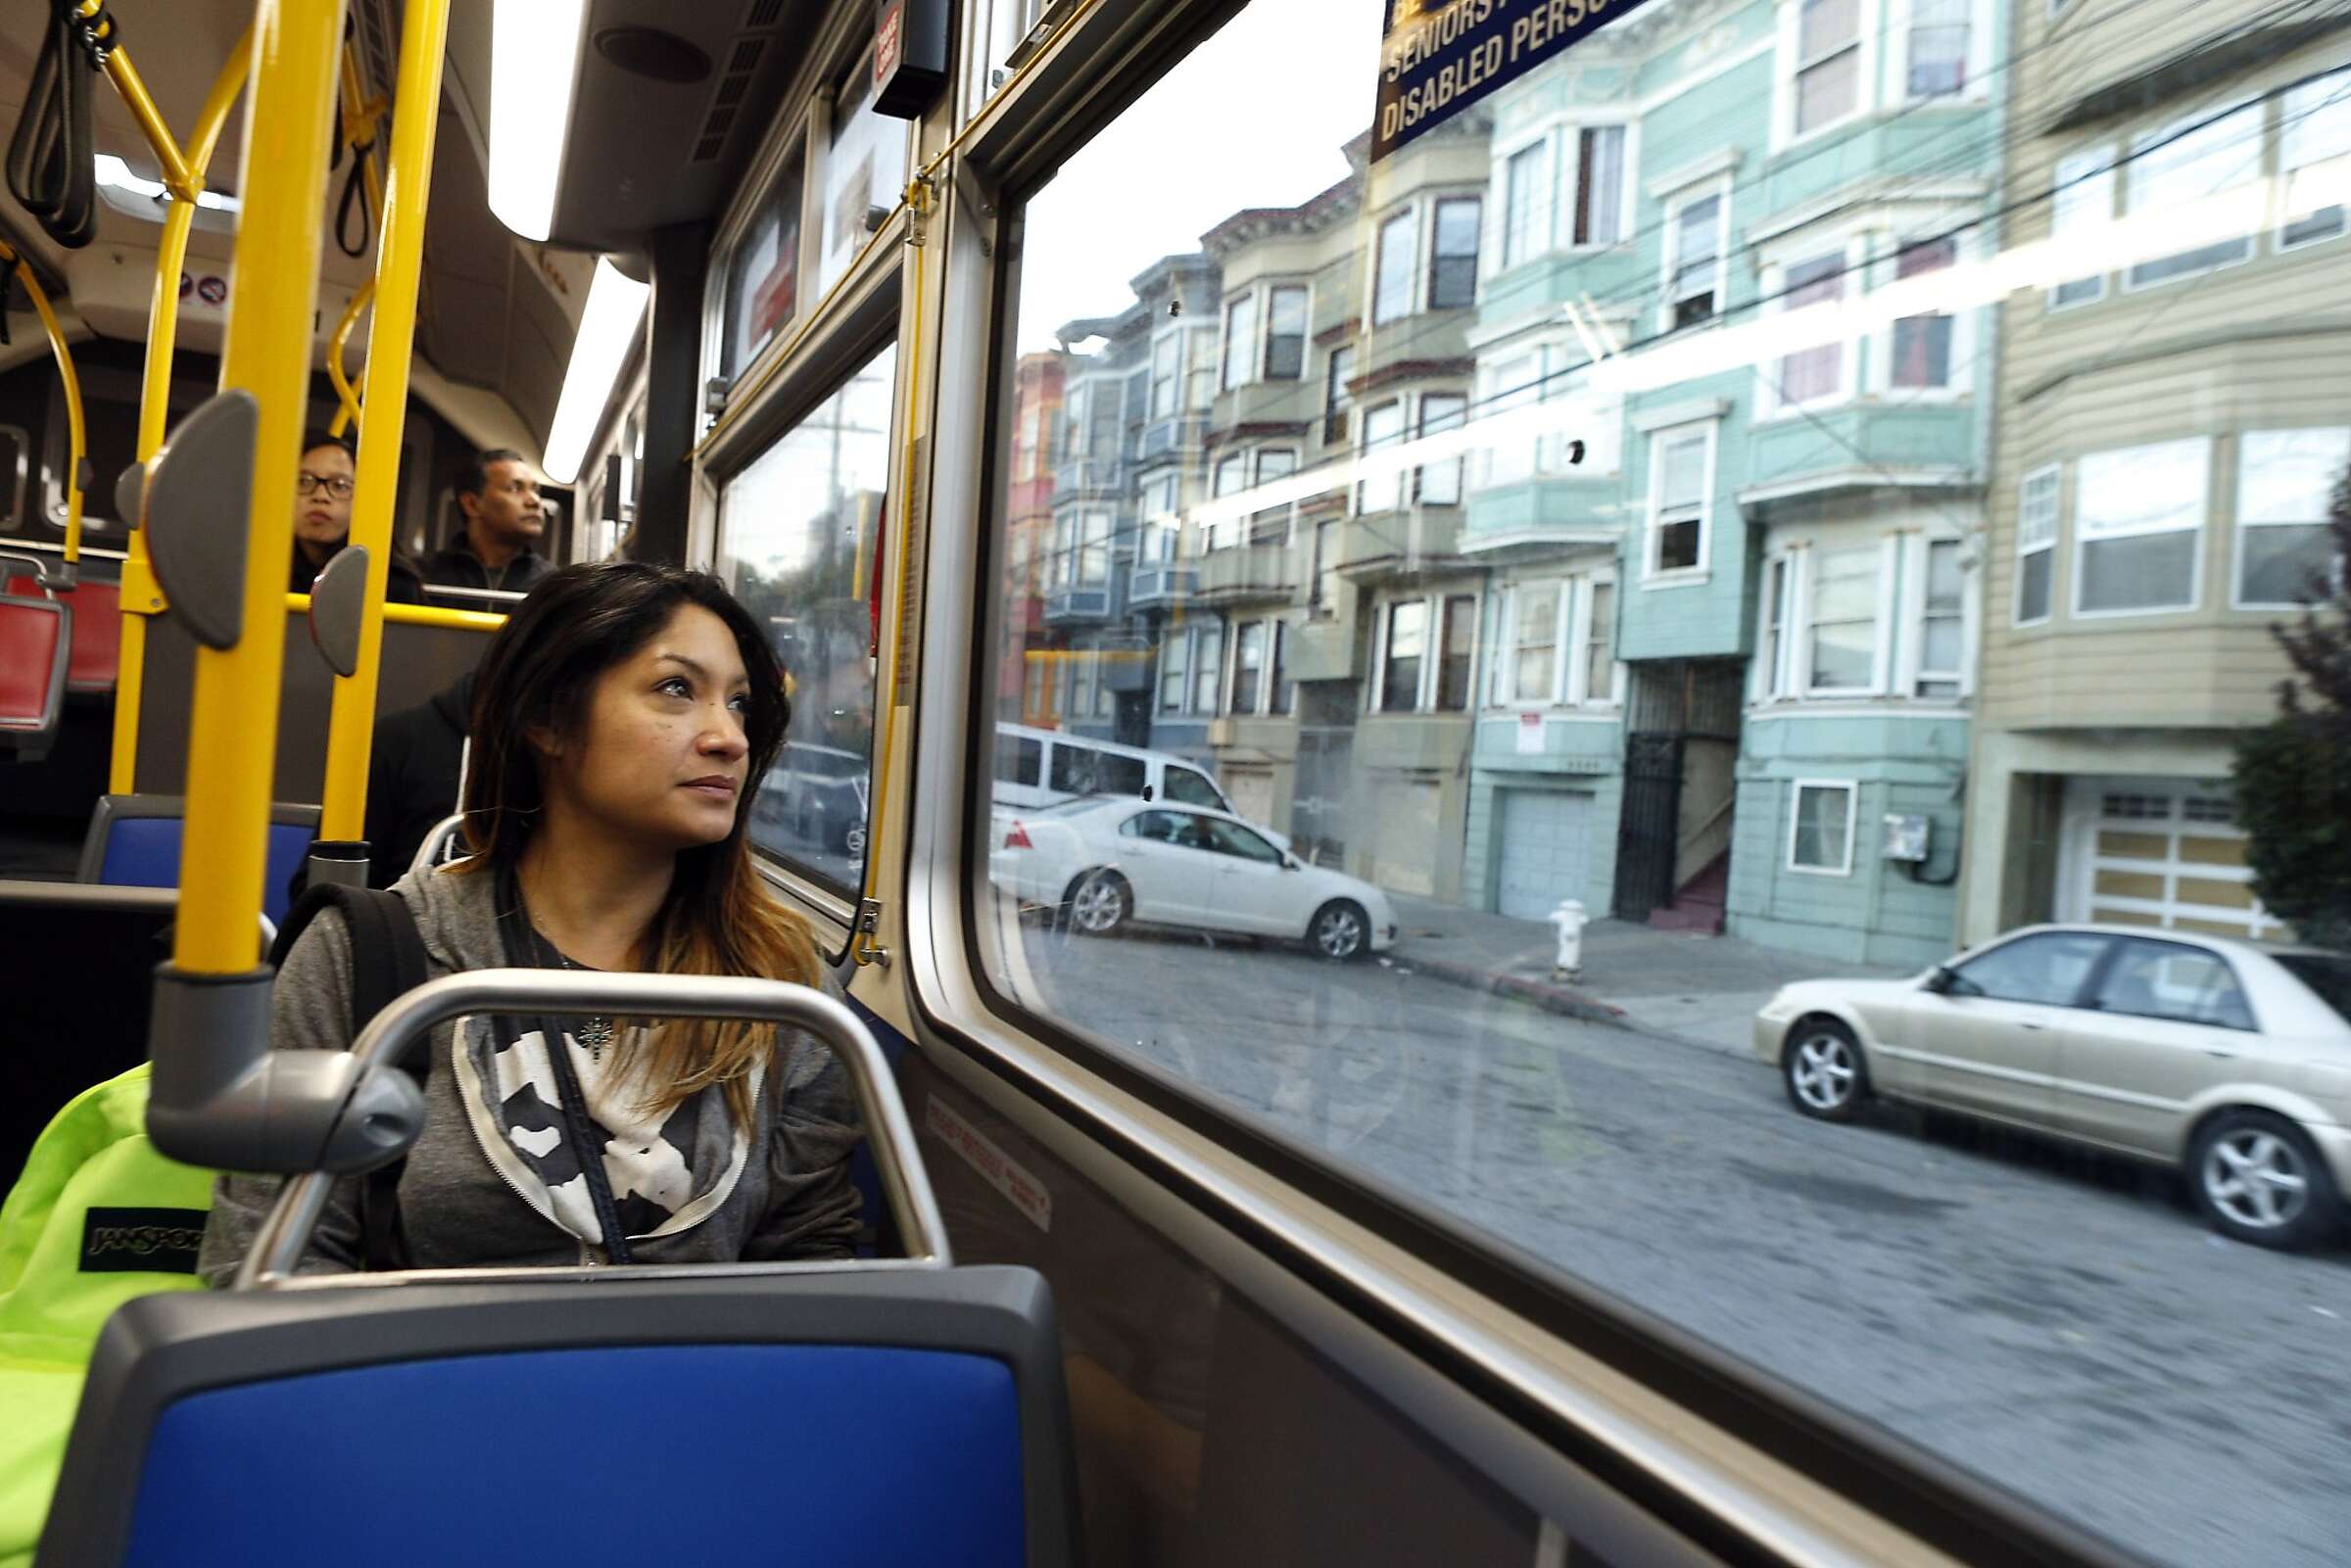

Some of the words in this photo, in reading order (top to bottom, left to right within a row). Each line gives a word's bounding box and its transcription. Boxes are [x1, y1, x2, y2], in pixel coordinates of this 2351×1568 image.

[1381, 34, 1503, 142] DISABLED
[1510, 0, 1616, 62] PERS
[1386, 0, 1493, 82] SENIORS
